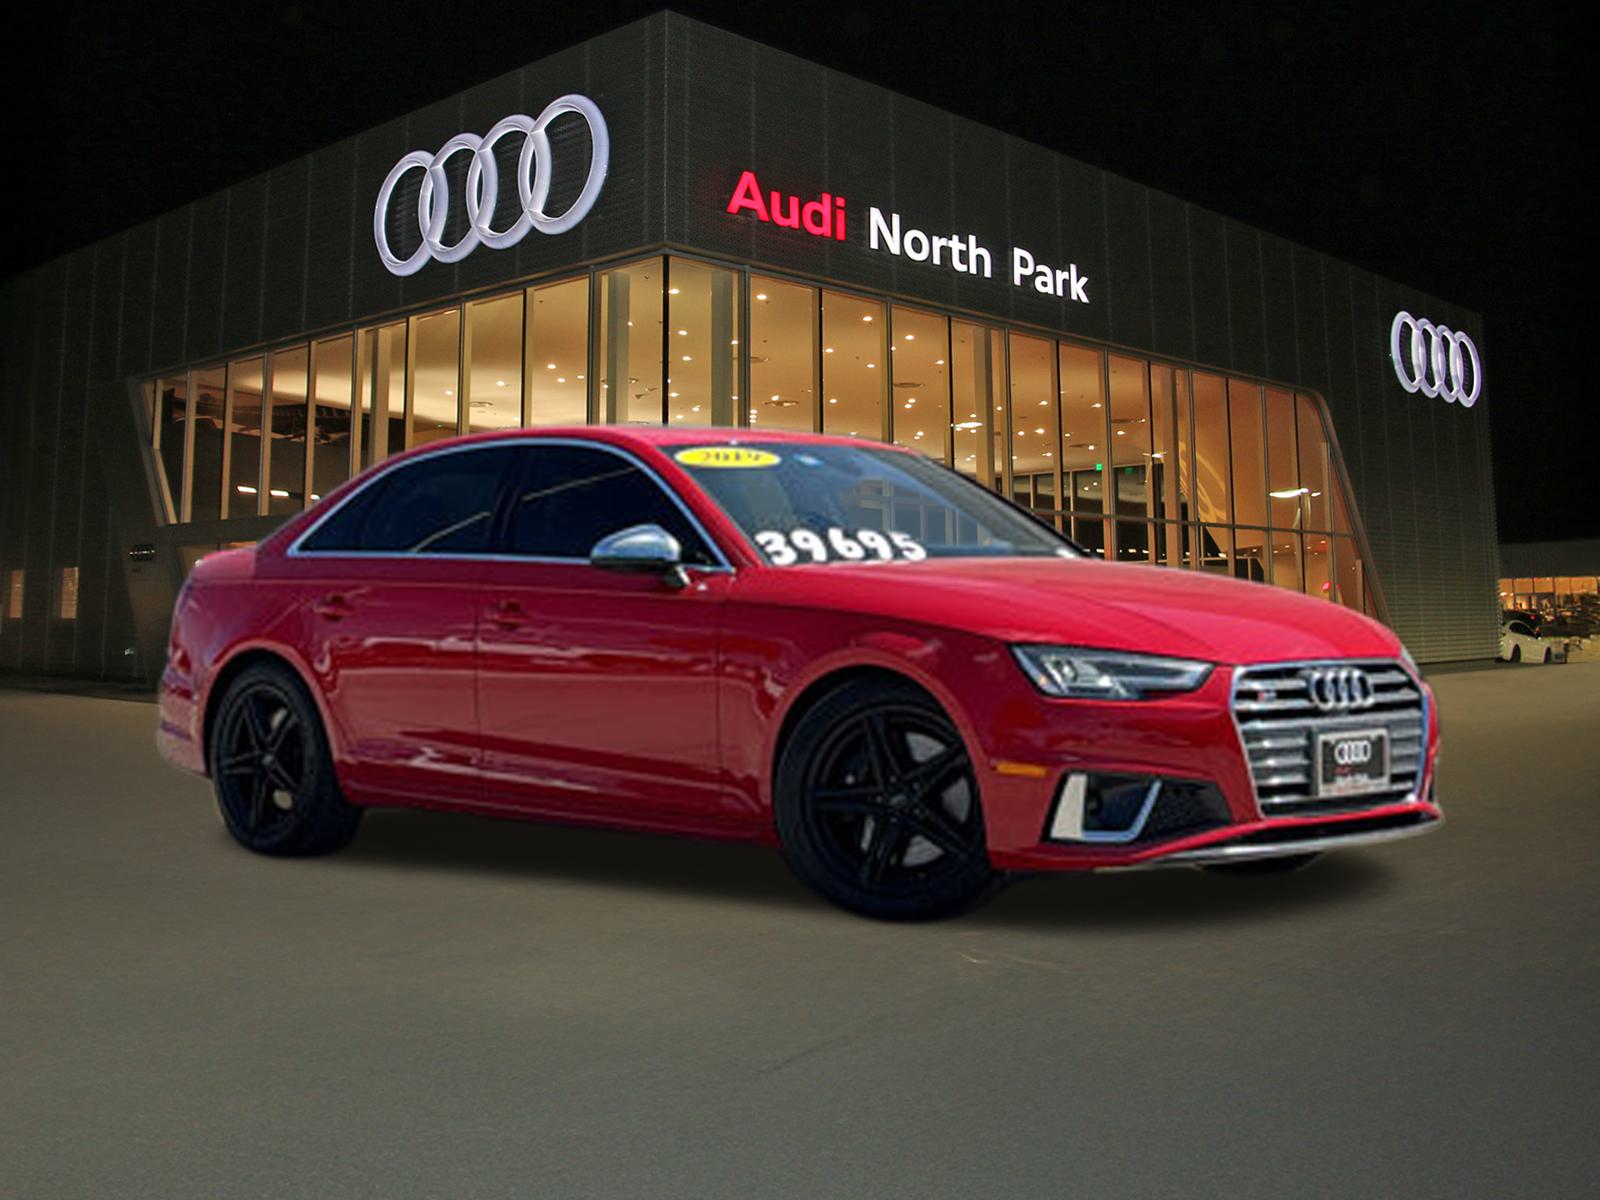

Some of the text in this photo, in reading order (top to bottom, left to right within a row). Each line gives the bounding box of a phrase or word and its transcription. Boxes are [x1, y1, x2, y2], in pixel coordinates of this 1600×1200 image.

[727, 171, 1090, 303] Audi North Park
[755, 527, 927, 566] 39695
